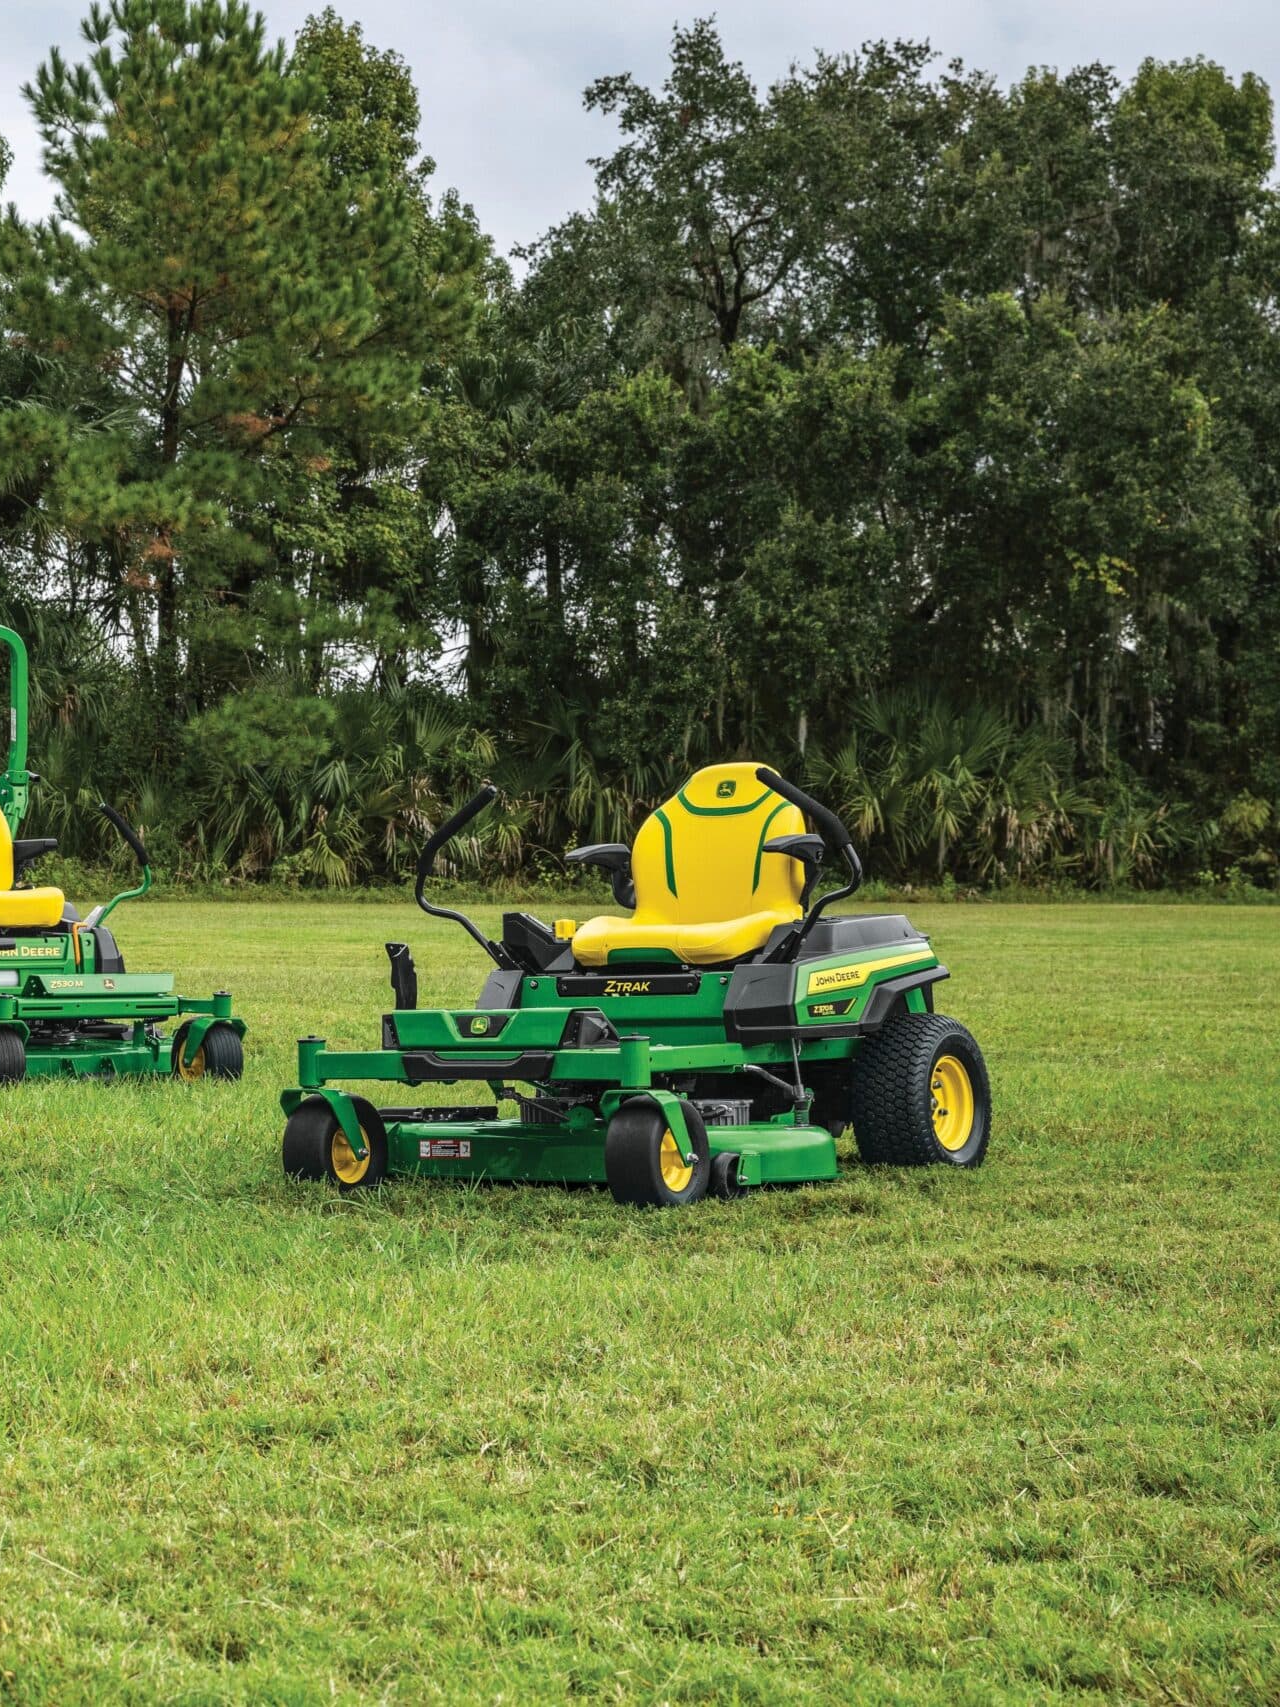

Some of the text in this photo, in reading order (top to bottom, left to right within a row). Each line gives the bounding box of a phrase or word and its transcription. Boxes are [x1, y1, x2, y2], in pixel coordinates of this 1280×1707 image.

[21, 946, 61, 957] DEERE
[816, 970, 860, 986] JOHN DEERE
[604, 980, 651, 992] ZTRAK
